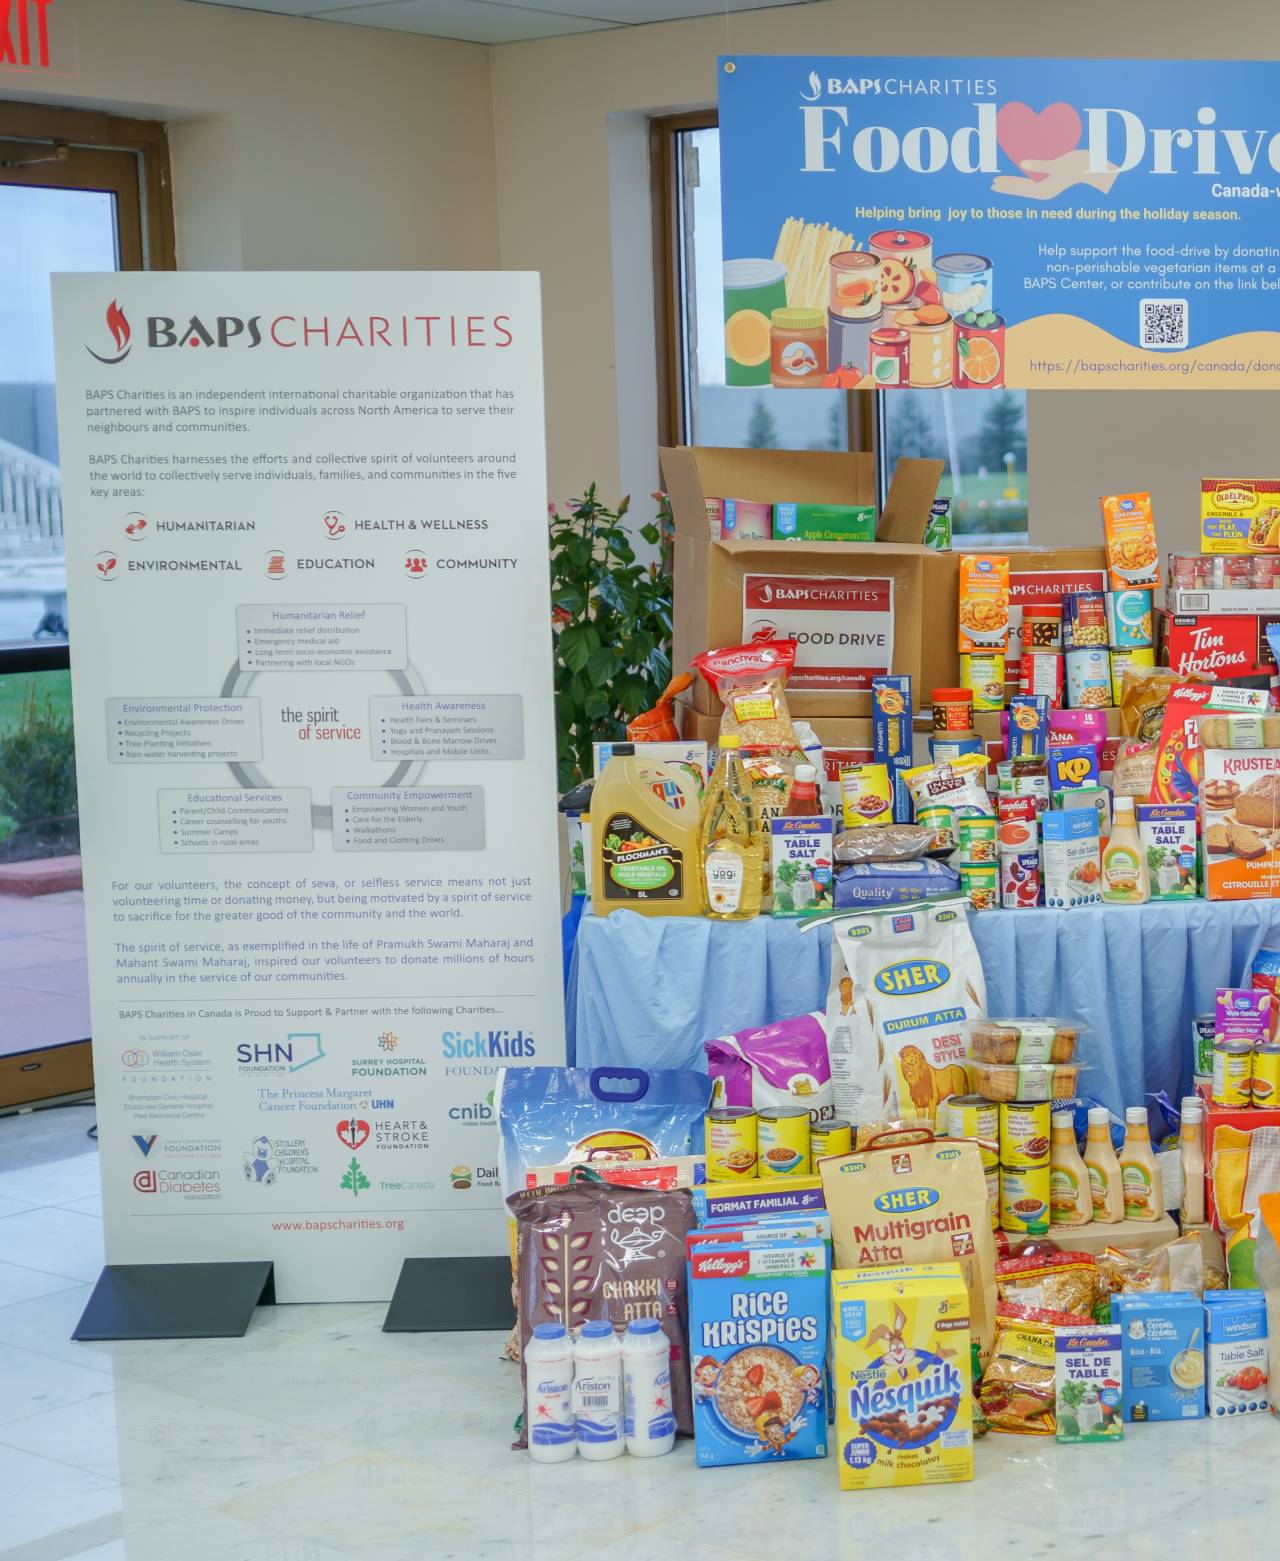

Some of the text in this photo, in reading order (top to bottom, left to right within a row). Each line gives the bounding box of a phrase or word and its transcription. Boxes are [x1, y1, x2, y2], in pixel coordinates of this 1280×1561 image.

[0, 0, 54, 67] XIT
[799, 103, 1001, 174] Food
[855, 206, 1240, 222] Helping bring joy to those in need during the holiday season.
[1039, 243, 1068, 259] Help
[1070, 246, 1118, 260] support
[1122, 244, 1142, 260] the
[1146, 243, 1210, 256] food-drive
[1214, 244, 1229, 260] by
[1046, 259, 1276, 276] non-perishable vegetarian items at a
[1024, 276, 1056, 289] BAPS
[1060, 275, 1107, 291] Center,
[1111, 280, 1124, 289] or
[1127, 275, 1191, 290] contribute
[1195, 281, 1210, 289] on
[1214, 277, 1234, 289] the
[1238, 277, 1258, 290] link
[157, 521, 255, 531] HUMANITARIAN
[355, 520, 488, 530] HEALTH & WELLNESS
[803, 530, 822, 540] Apple
[128, 560, 242, 571] ENVIRONMENTAL
[298, 559, 374, 569] EDUCATION
[436, 559, 518, 568] COMMUNITY
[839, 634, 885, 646] DRIVE
[1190, 627, 1223, 650] Tim
[1178, 650, 1247, 674] Hortons
[281, 707, 339, 726] the spirit
[1151, 826, 1185, 835] TABLE
[785, 839, 820, 848] TABLE
[1155, 836, 1181, 845] SALT
[617, 848, 669, 862] PLOCHMAN'S
[789, 850, 816, 858] SALT
[1222, 880, 1269, 889] CITROUILLE
[853, 887, 892, 900] Quality
[882, 965, 941, 992] SHER
[887, 1009, 964, 1032] DURUM ATTA
[441, 1031, 535, 1058] SickKids
[932, 1034, 961, 1049] DESI
[237, 1043, 293, 1063] SHN
[933, 1047, 966, 1063] STYLE
[352, 1067, 427, 1076] FOUNDATION
[258, 1088, 372, 1099] The Princess Margaret
[259, 1100, 394, 1111] Cancer Foundation UHN
[449, 1103, 491, 1119] cnib
[376, 1132, 428, 1141] STROKE
[158, 1170, 219, 1180] Canadian
[160, 1182, 220, 1193] Diabetes
[711, 1197, 798, 1213] FORMAT FAMILIAL
[880, 1190, 931, 1210] SHER
[608, 1205, 665, 1224] deep
[272, 1216, 404, 1233] www.bapscharities.org
[854, 1212, 971, 1243] Multigrain
[859, 1244, 903, 1263] Atta
[698, 1258, 743, 1273] Kellogg's
[602, 1280, 662, 1299] CHAKKI
[624, 1301, 662, 1320] ATTA
[732, 1291, 788, 1318] Rice
[1224, 1322, 1258, 1332] windsor
[1066, 1357, 1111, 1367] SEL DE
[1220, 1349, 1264, 1361] Table Salt
[1069, 1369, 1108, 1378] TABLE
[536, 1380, 568, 1394] Ariston
[575, 1378, 610, 1391] Ariston
[850, 1363, 962, 1419] Nesquik
[877, 1455, 940, 1468] milk chocolatey
